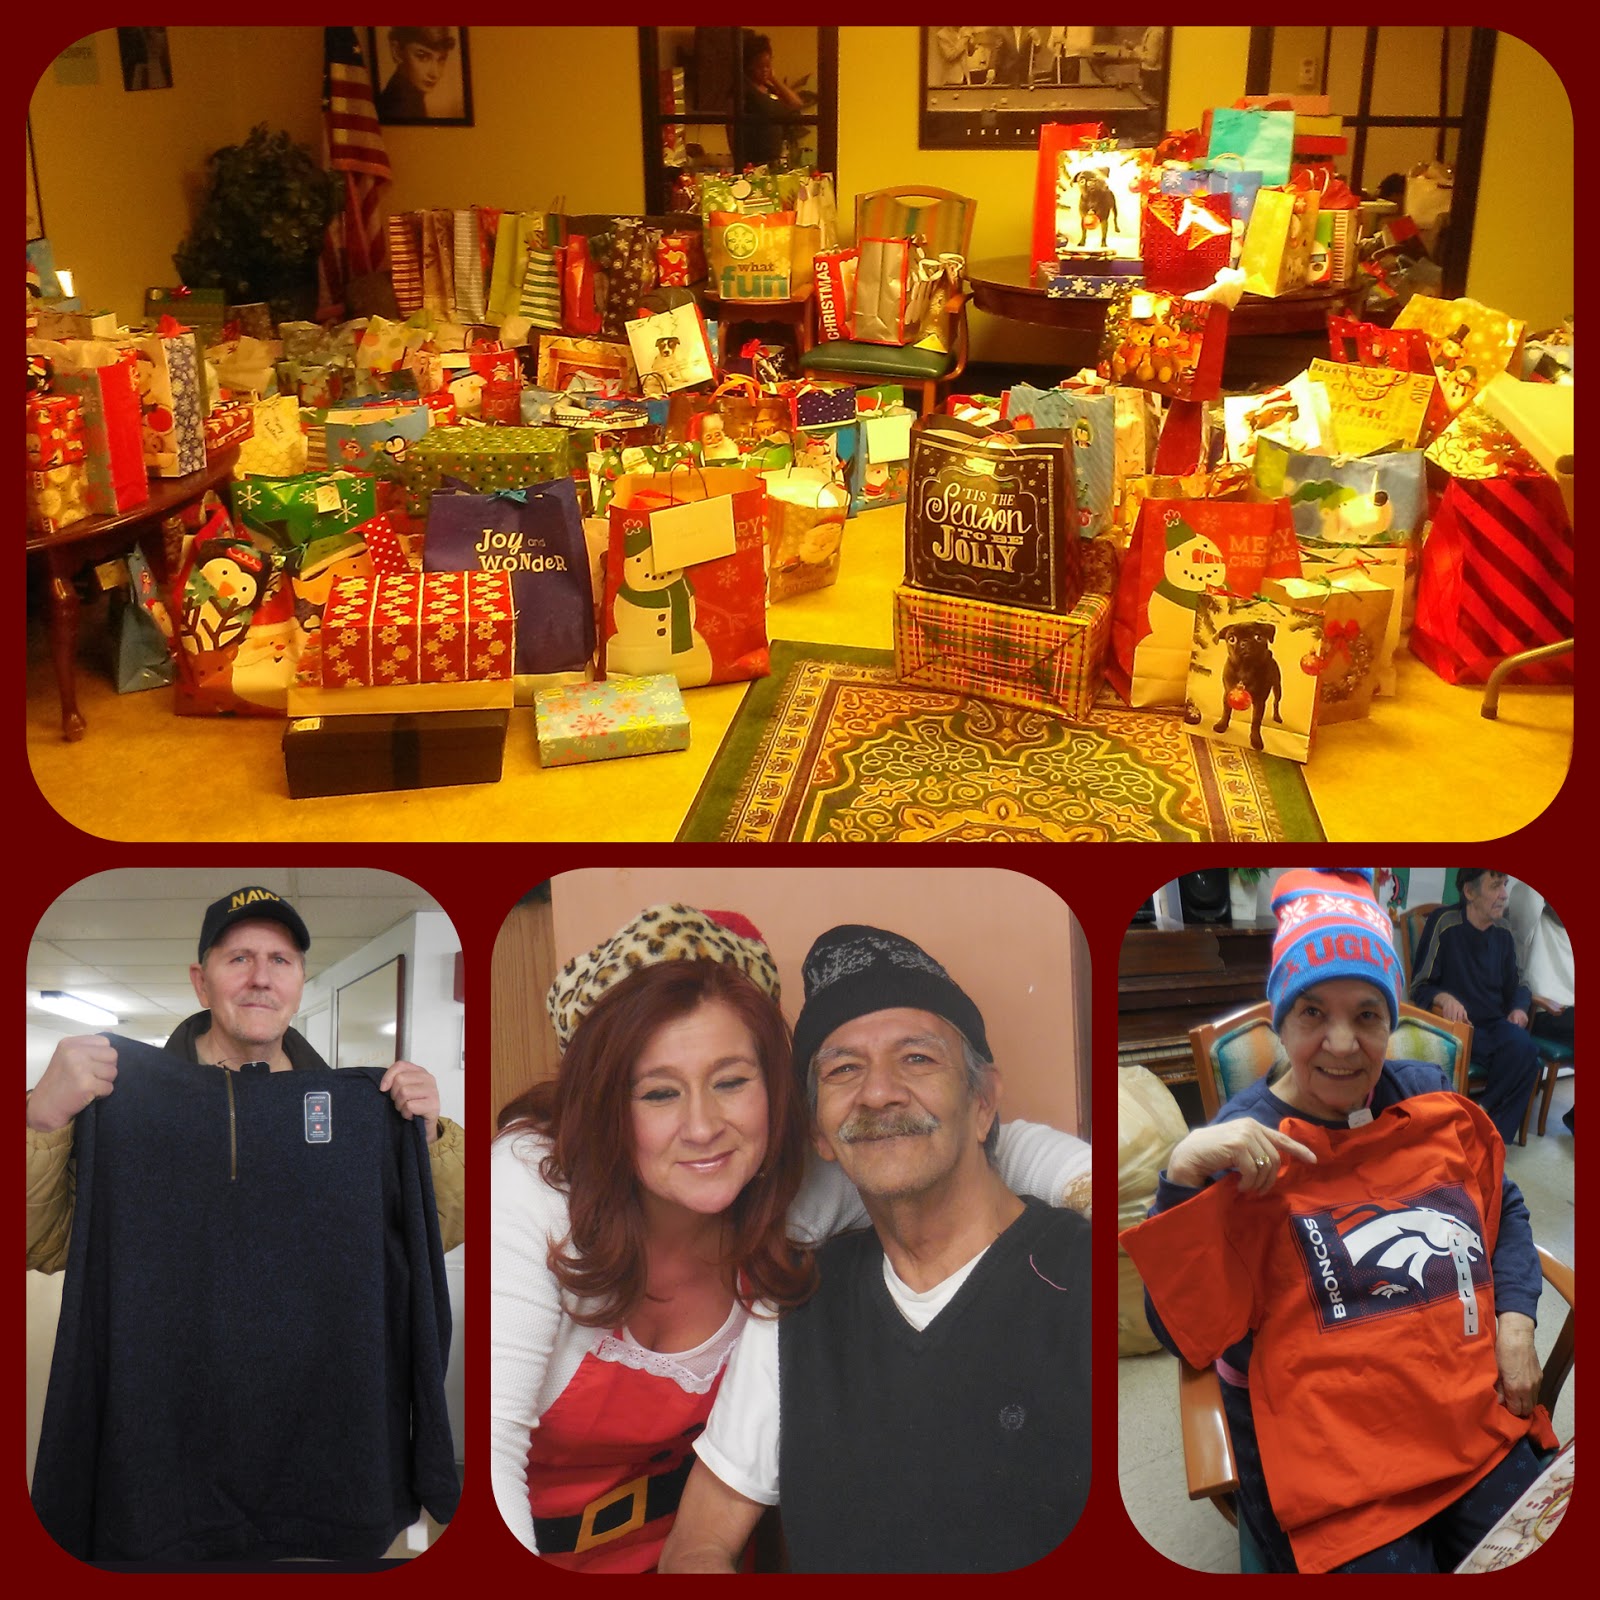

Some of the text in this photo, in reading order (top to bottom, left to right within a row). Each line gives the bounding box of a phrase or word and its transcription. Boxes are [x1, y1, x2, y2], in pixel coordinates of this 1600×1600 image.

[737, 262, 775, 273] what
[720, 266, 787, 298] fun
[815, 261, 840, 341] CHRISTMAS
[486, 399, 518, 412] JOY
[991, 493, 1016, 507] THE
[925, 482, 1033, 534] Season
[475, 529, 524, 556] Joy
[957, 528, 1024, 546] TO BE
[932, 524, 1019, 573] JOLLY
[1304, 933, 1395, 975] UGLY
[1453, 1239, 1460, 1247] L
[1457, 1255, 1464, 1264] L
[1303, 1218, 1347, 1319] BRONCOS
[1462, 1272, 1468, 1281] L
[1464, 1290, 1471, 1298] L
[1468, 1306, 1474, 1315] L
[1469, 1324, 1474, 1333] L
